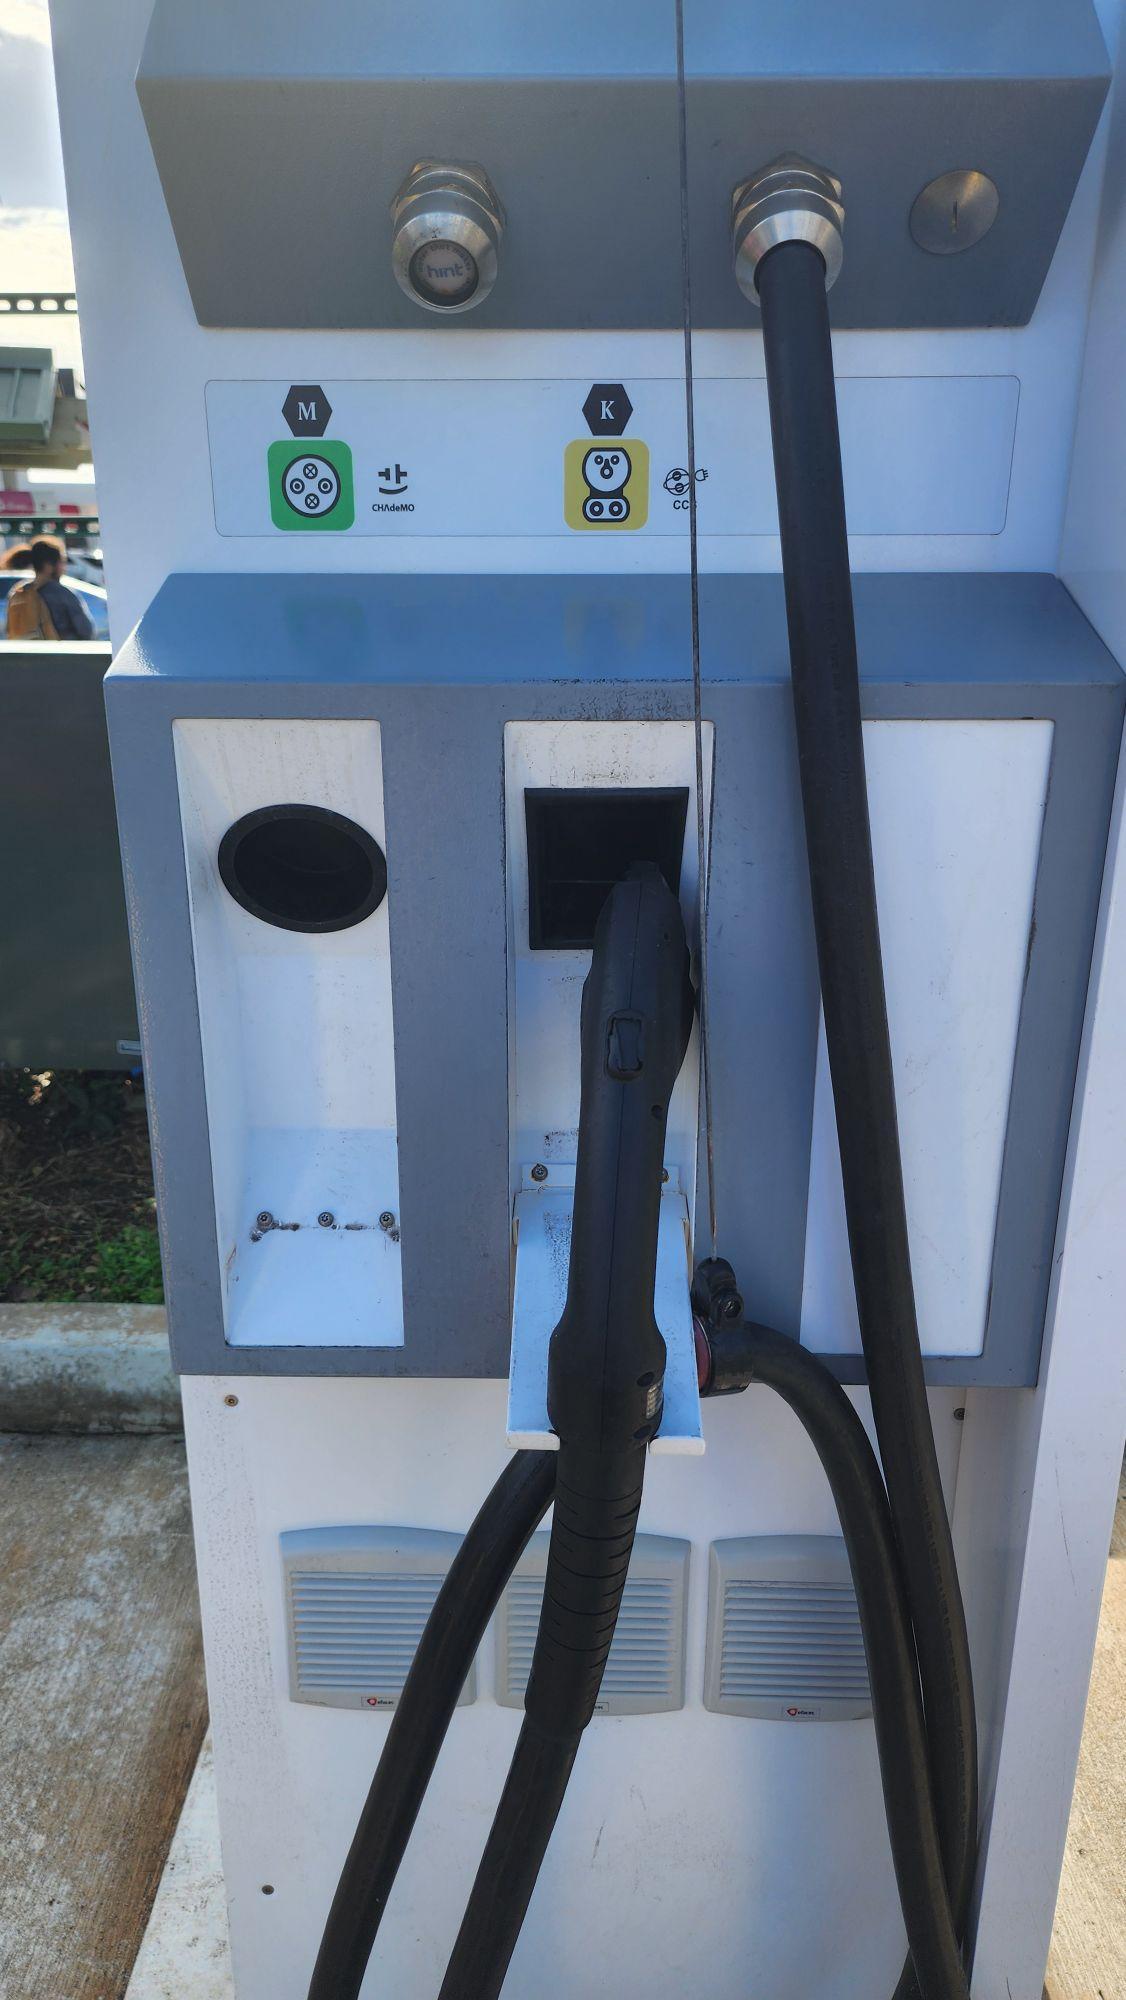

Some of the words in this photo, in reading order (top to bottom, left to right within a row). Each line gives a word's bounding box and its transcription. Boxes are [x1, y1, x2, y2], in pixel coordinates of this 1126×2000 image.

[297, 401, 317, 421] M
[600, 400, 615, 420] K
[371, 503, 415, 512] CHAdeMO
[673, 499, 697, 510] CC
